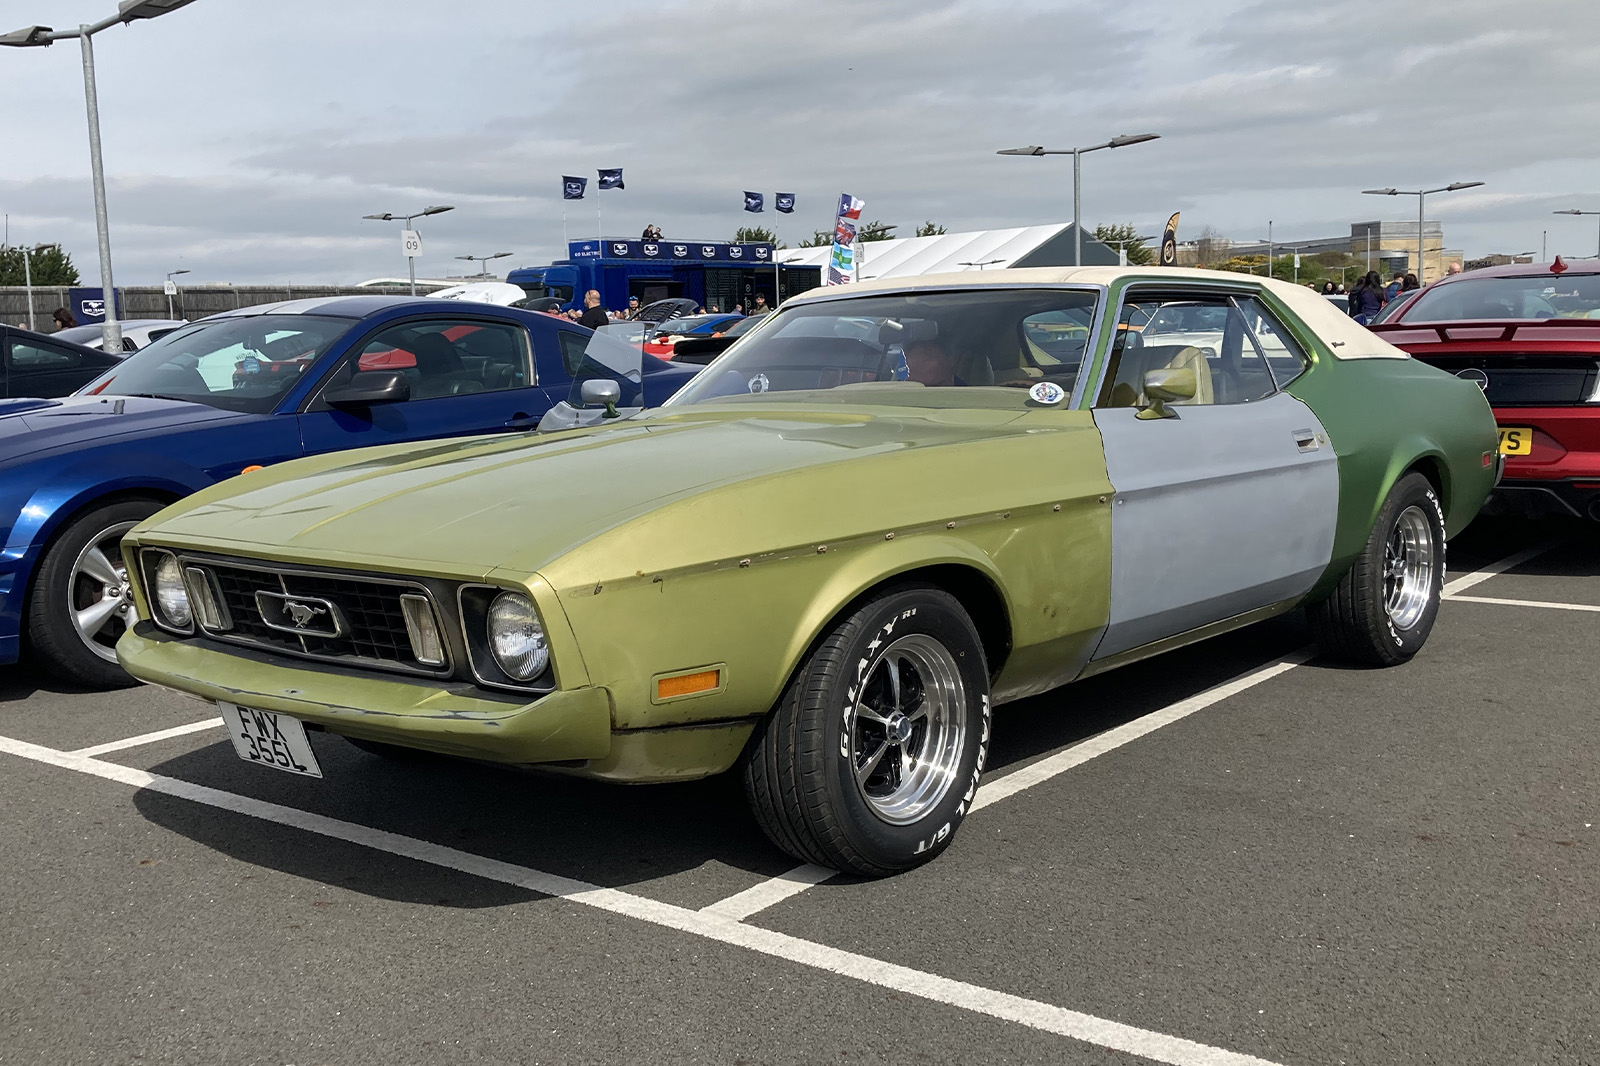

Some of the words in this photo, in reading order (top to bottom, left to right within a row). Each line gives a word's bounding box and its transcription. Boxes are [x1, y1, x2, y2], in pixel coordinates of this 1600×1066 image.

[406, 240, 418, 250] 09
[840, 615, 899, 759] GALAXY
[901, 607, 918, 620] R1
[236, 706, 288, 743] FWX
[240, 732, 308, 773] 355L
[955, 694, 990, 817] RADIAL
